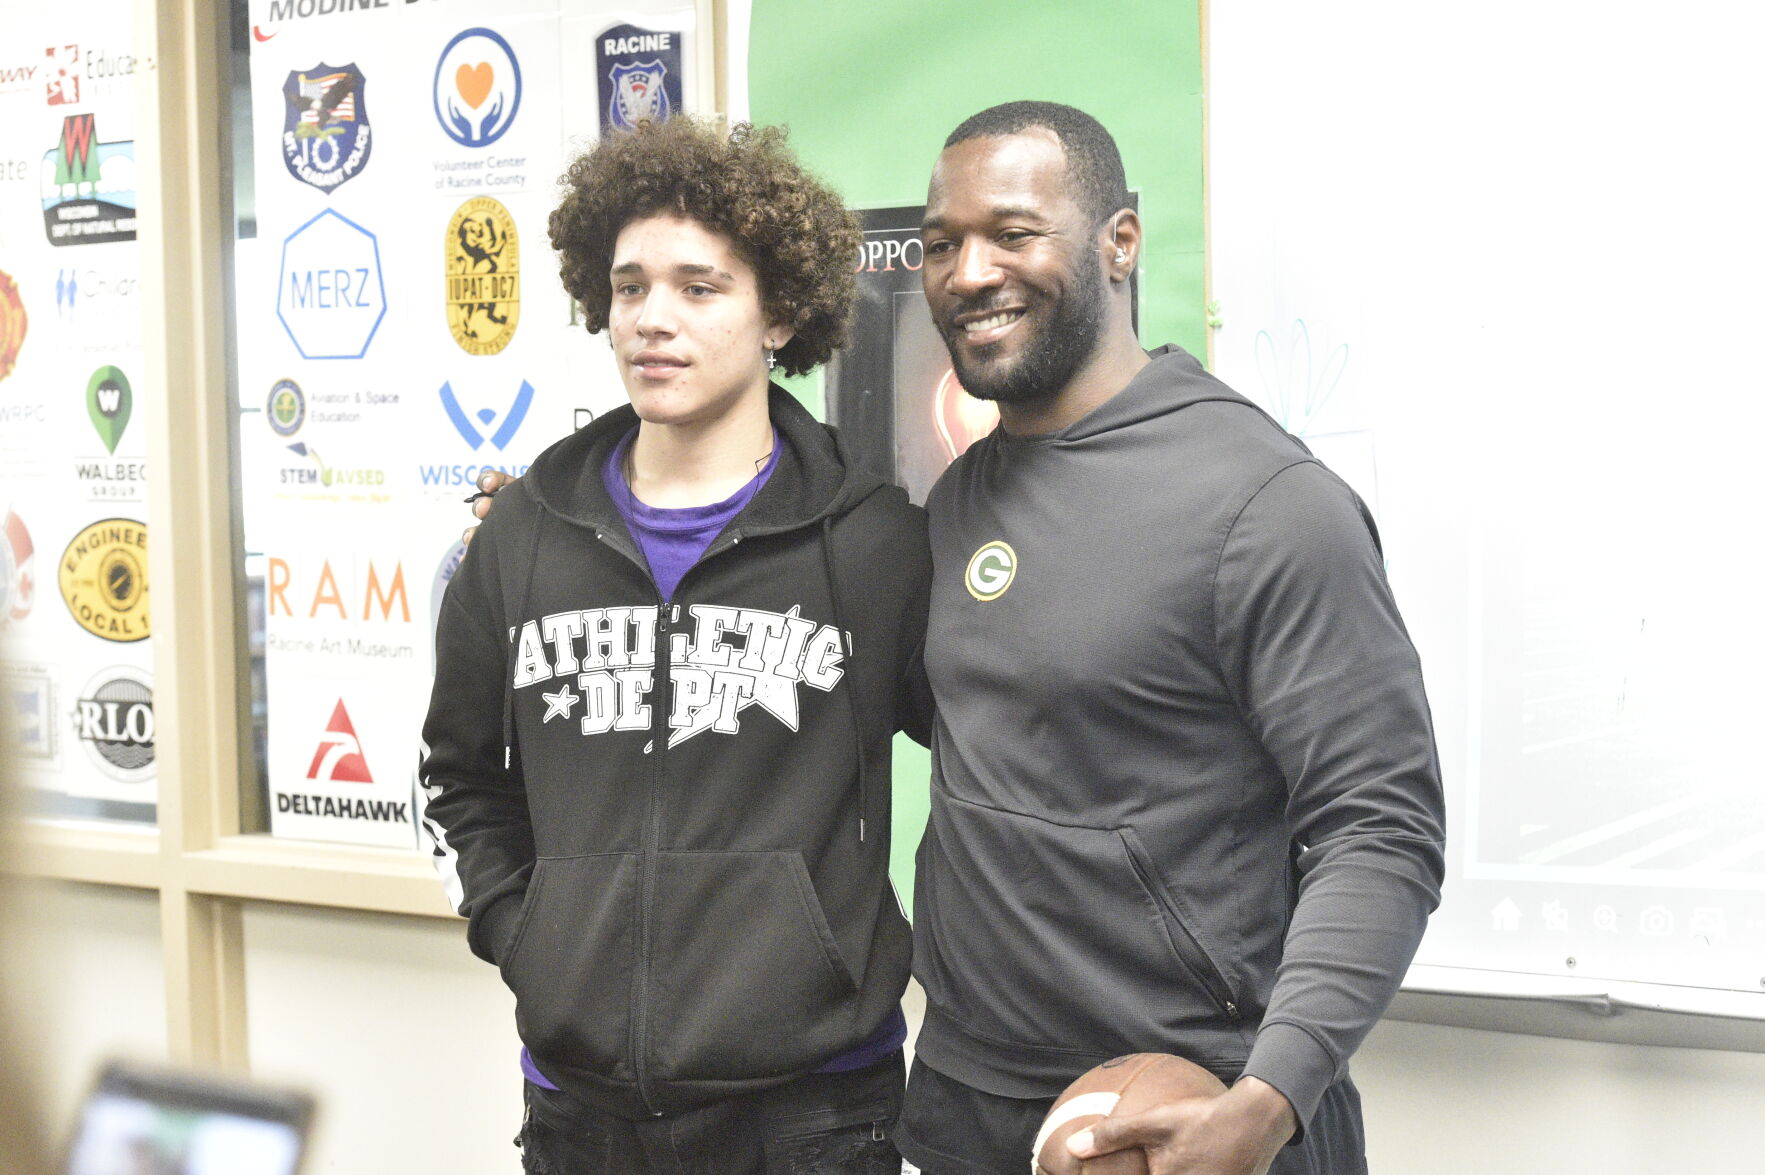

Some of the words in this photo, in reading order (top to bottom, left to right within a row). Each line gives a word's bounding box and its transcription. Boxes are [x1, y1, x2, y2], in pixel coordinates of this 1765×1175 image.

[604, 33, 671, 56] RACINE
[432, 159, 485, 172] Volunteer
[486, 155, 527, 169] Center
[434, 177, 445, 190] of
[447, 174, 483, 189] Racine
[484, 172, 527, 188] County
[291, 268, 371, 310] MERZ
[99, 390, 120, 412] W
[365, 389, 400, 407] Space
[310, 409, 362, 423] Education
[280, 467, 318, 485] STEM
[336, 468, 385, 487] AVSED
[418, 463, 531, 487] WISC
[968, 546, 1013, 595] G
[70, 593, 133, 634] LOCAL
[267, 633, 315, 653] Racine
[319, 637, 343, 655] Art
[346, 637, 413, 660] Museum
[510, 604, 852, 691] ATHLETIC
[275, 791, 411, 825] DELTAHAWK
